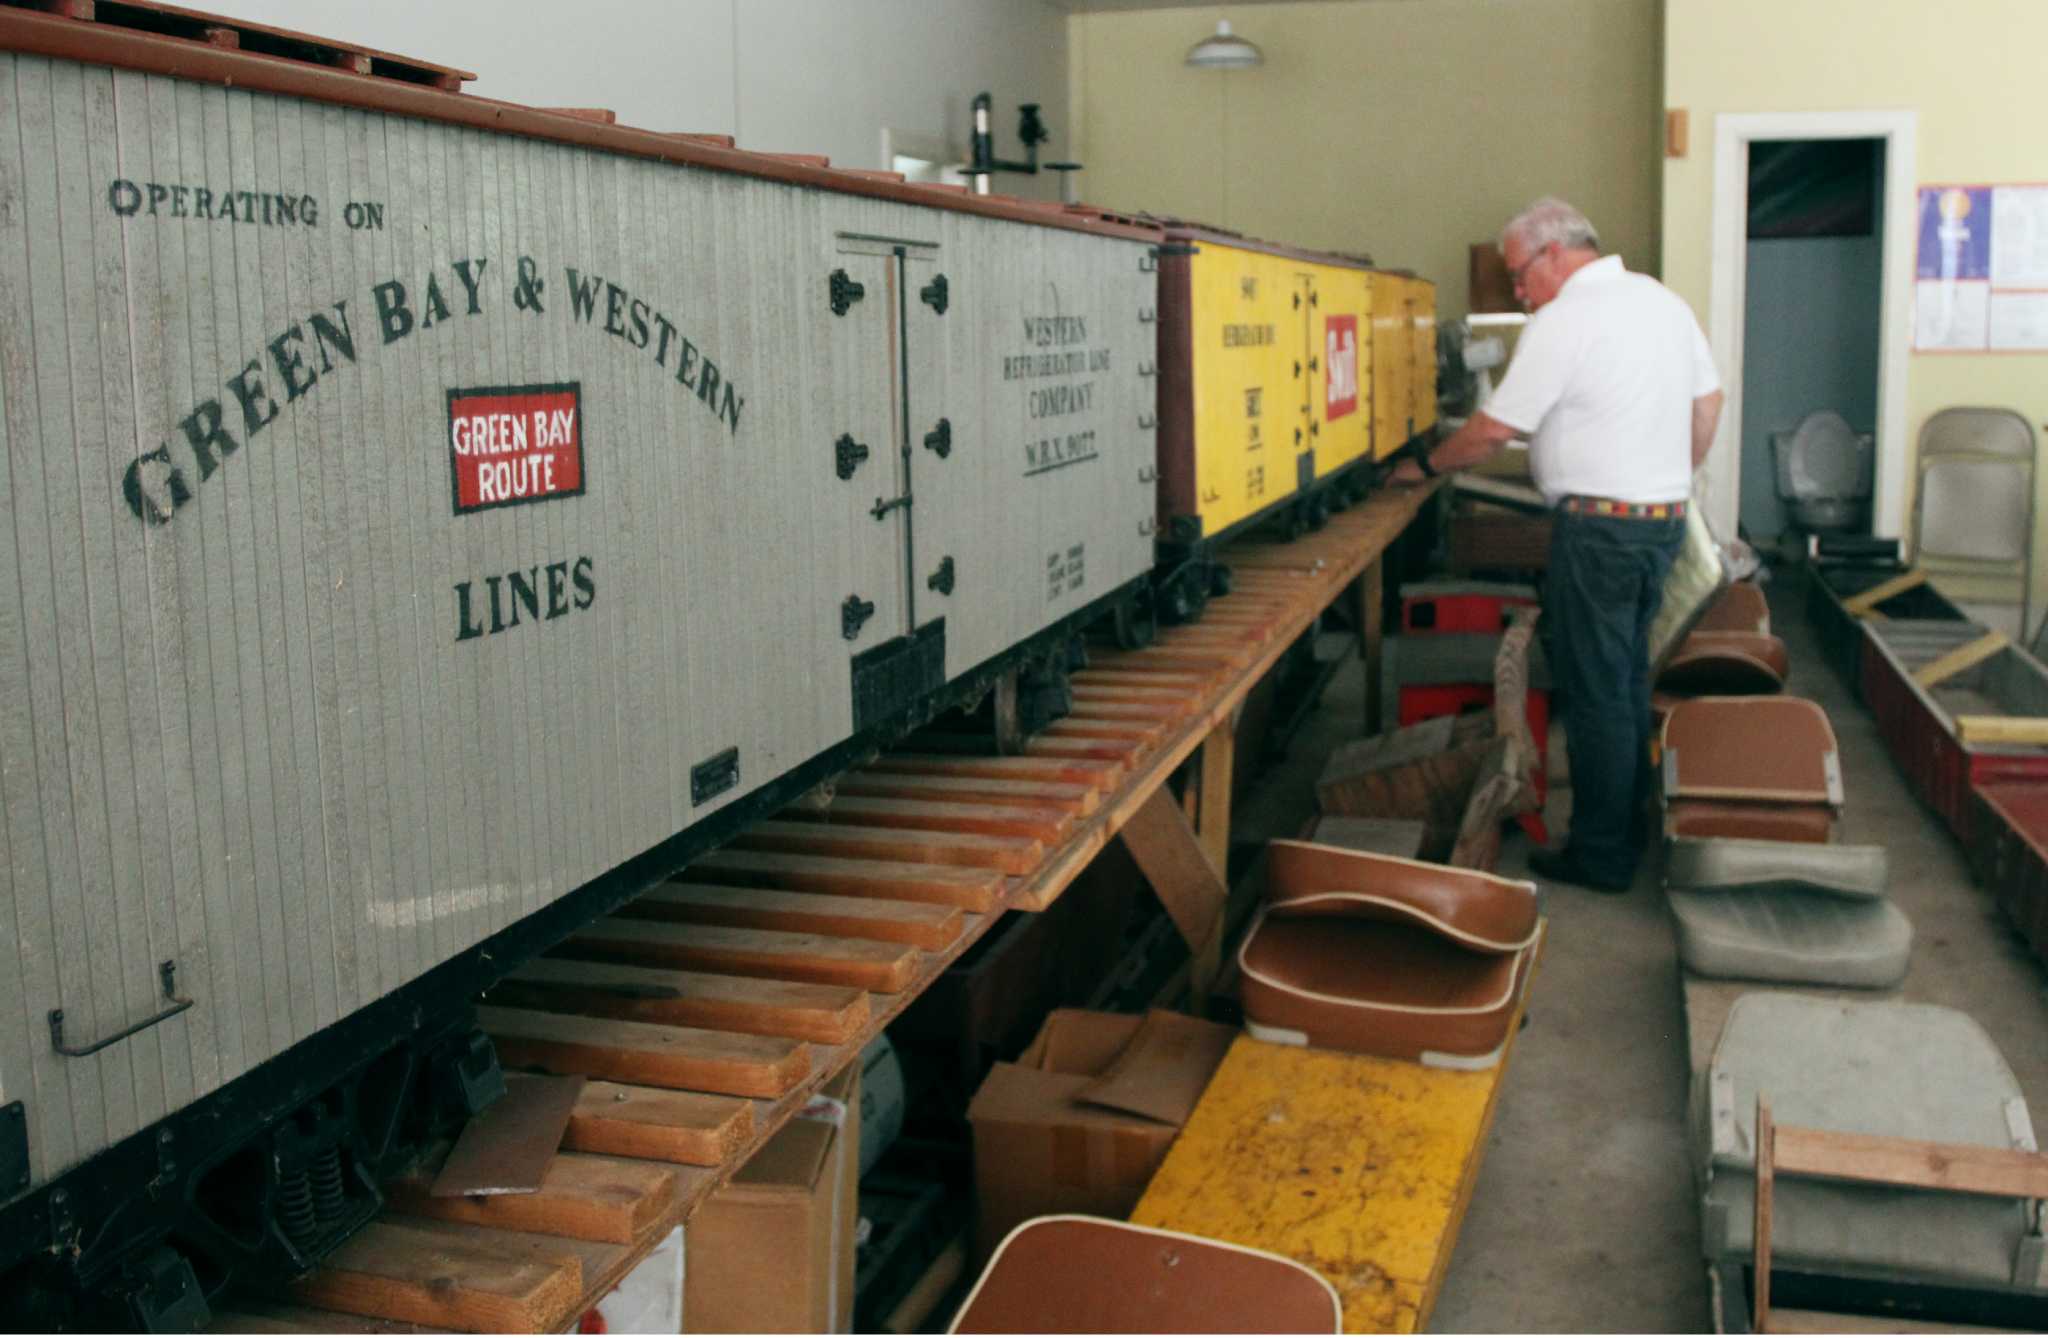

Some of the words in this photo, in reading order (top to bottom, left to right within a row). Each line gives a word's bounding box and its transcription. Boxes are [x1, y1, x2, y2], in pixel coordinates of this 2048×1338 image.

[108, 179, 318, 227] OPERATING
[343, 201, 384, 231] ON
[122, 301, 358, 525] GREEN
[372, 256, 487, 346] BAY
[513, 255, 545, 314] &
[565, 267, 745, 436] WESTERN
[453, 415, 528, 456] GREEN
[534, 407, 574, 449] BAY
[478, 454, 556, 501] ROUTE
[453, 556, 596, 642] LINES
